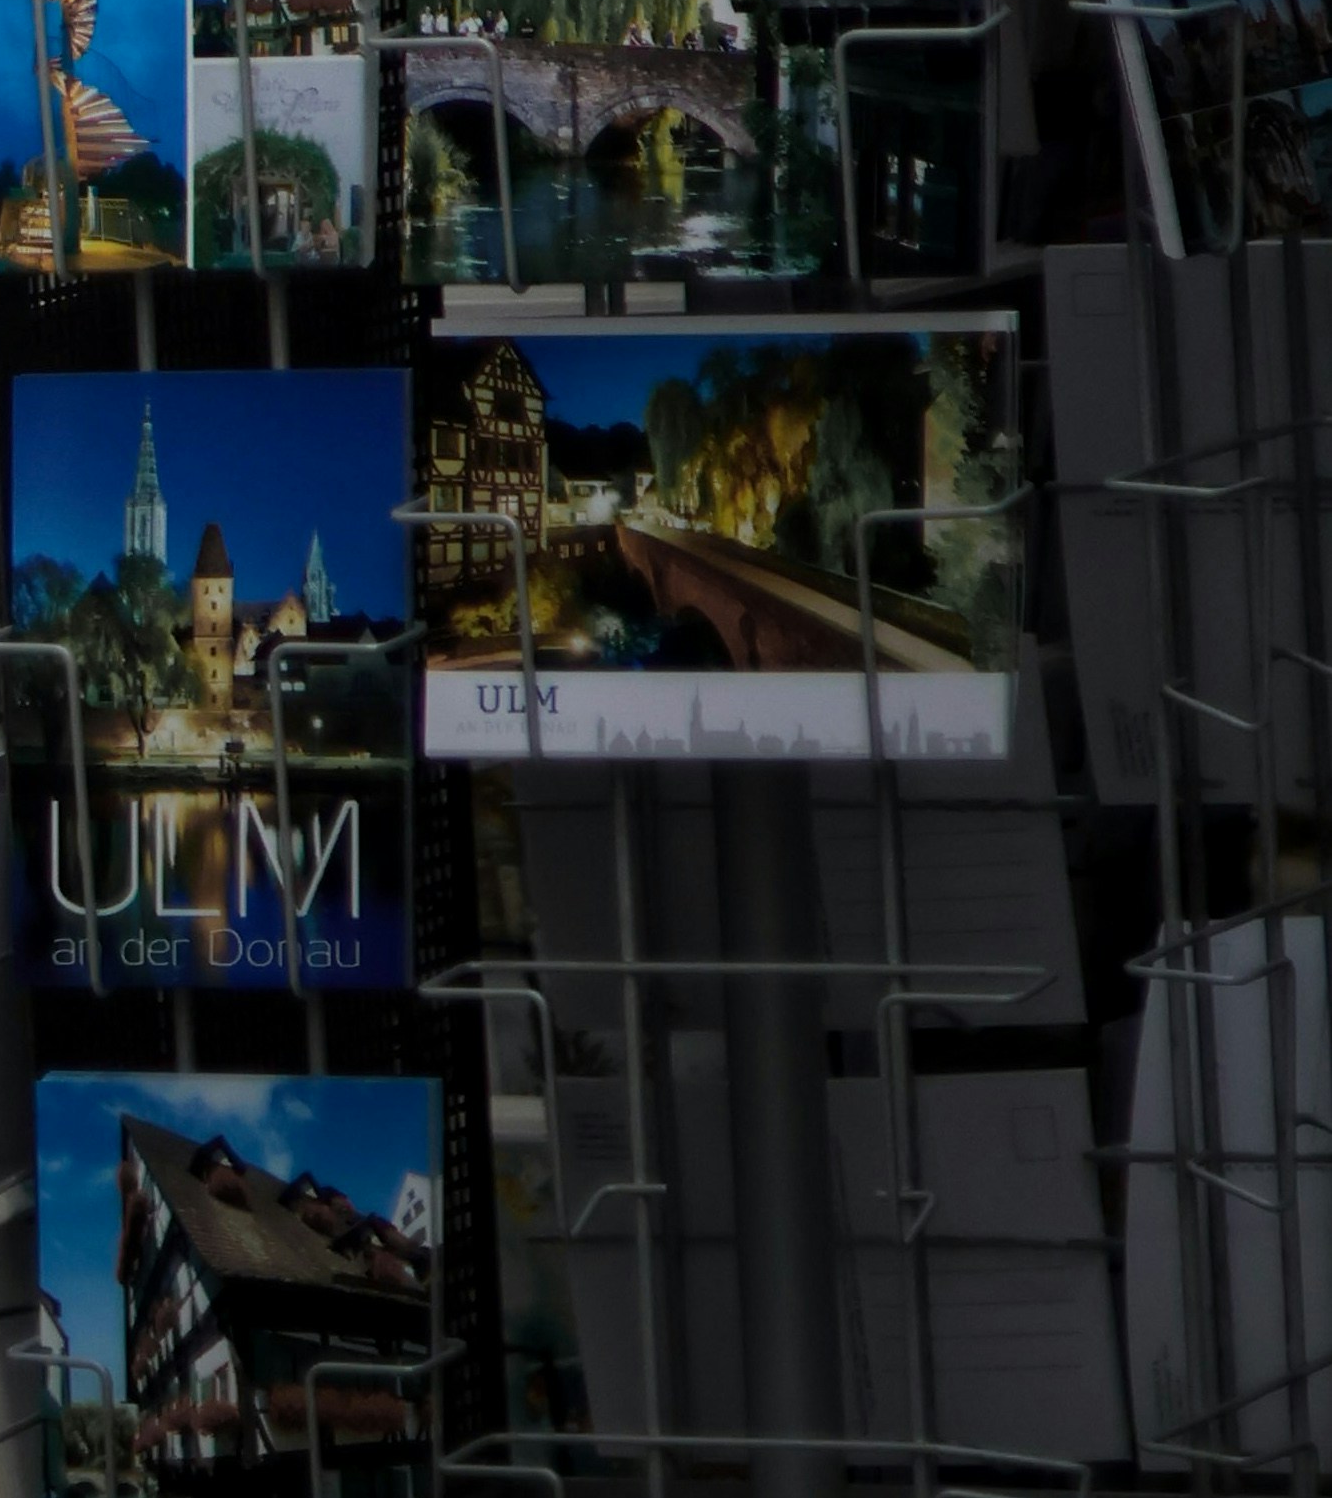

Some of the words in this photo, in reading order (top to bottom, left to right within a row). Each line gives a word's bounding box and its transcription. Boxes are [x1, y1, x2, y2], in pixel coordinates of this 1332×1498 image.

[477, 685, 560, 715] ULM
[50, 799, 360, 918] ULM
[120, 928, 191, 967] der
